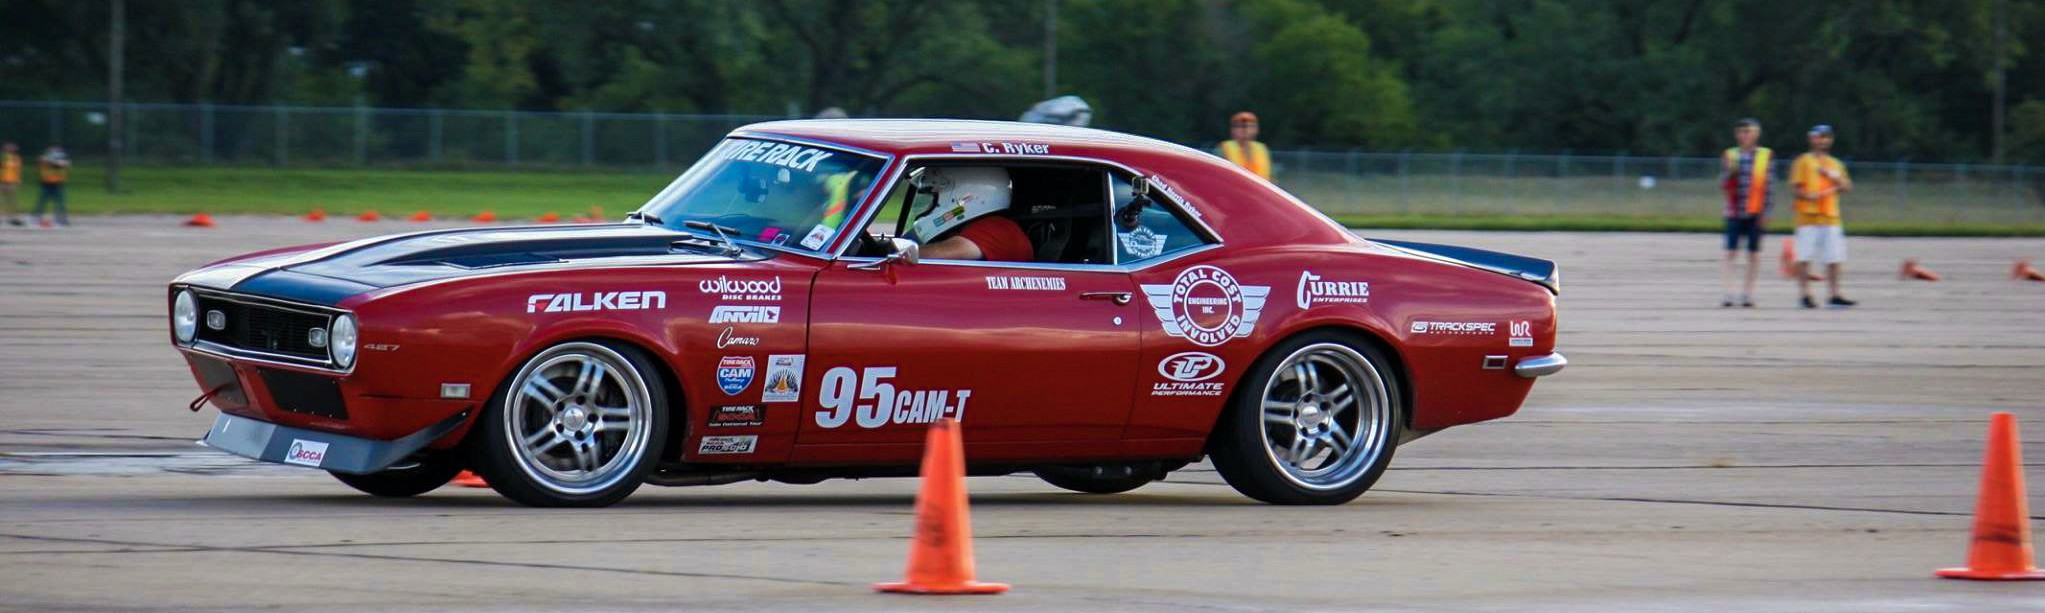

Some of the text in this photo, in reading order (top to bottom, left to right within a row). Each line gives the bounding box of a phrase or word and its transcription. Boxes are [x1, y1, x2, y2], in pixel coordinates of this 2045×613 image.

[982, 142, 1049, 155] C. Ryker
[699, 275, 781, 293] wilwood
[985, 276, 1066, 291] TEAM ARCHENEMIES
[1174, 269, 1242, 303] TOTAL COST
[1297, 270, 1369, 310] CURRIE
[527, 291, 666, 313] FALKEN
[1177, 315, 1240, 343] INVOLVED
[1429, 322, 1496, 332] TRACKSPEC
[717, 327, 760, 348] Camaro
[720, 368, 752, 378] CAM
[1153, 382, 1225, 390] ULTIMATE
[815, 366, 972, 429] 95 CAM-T
